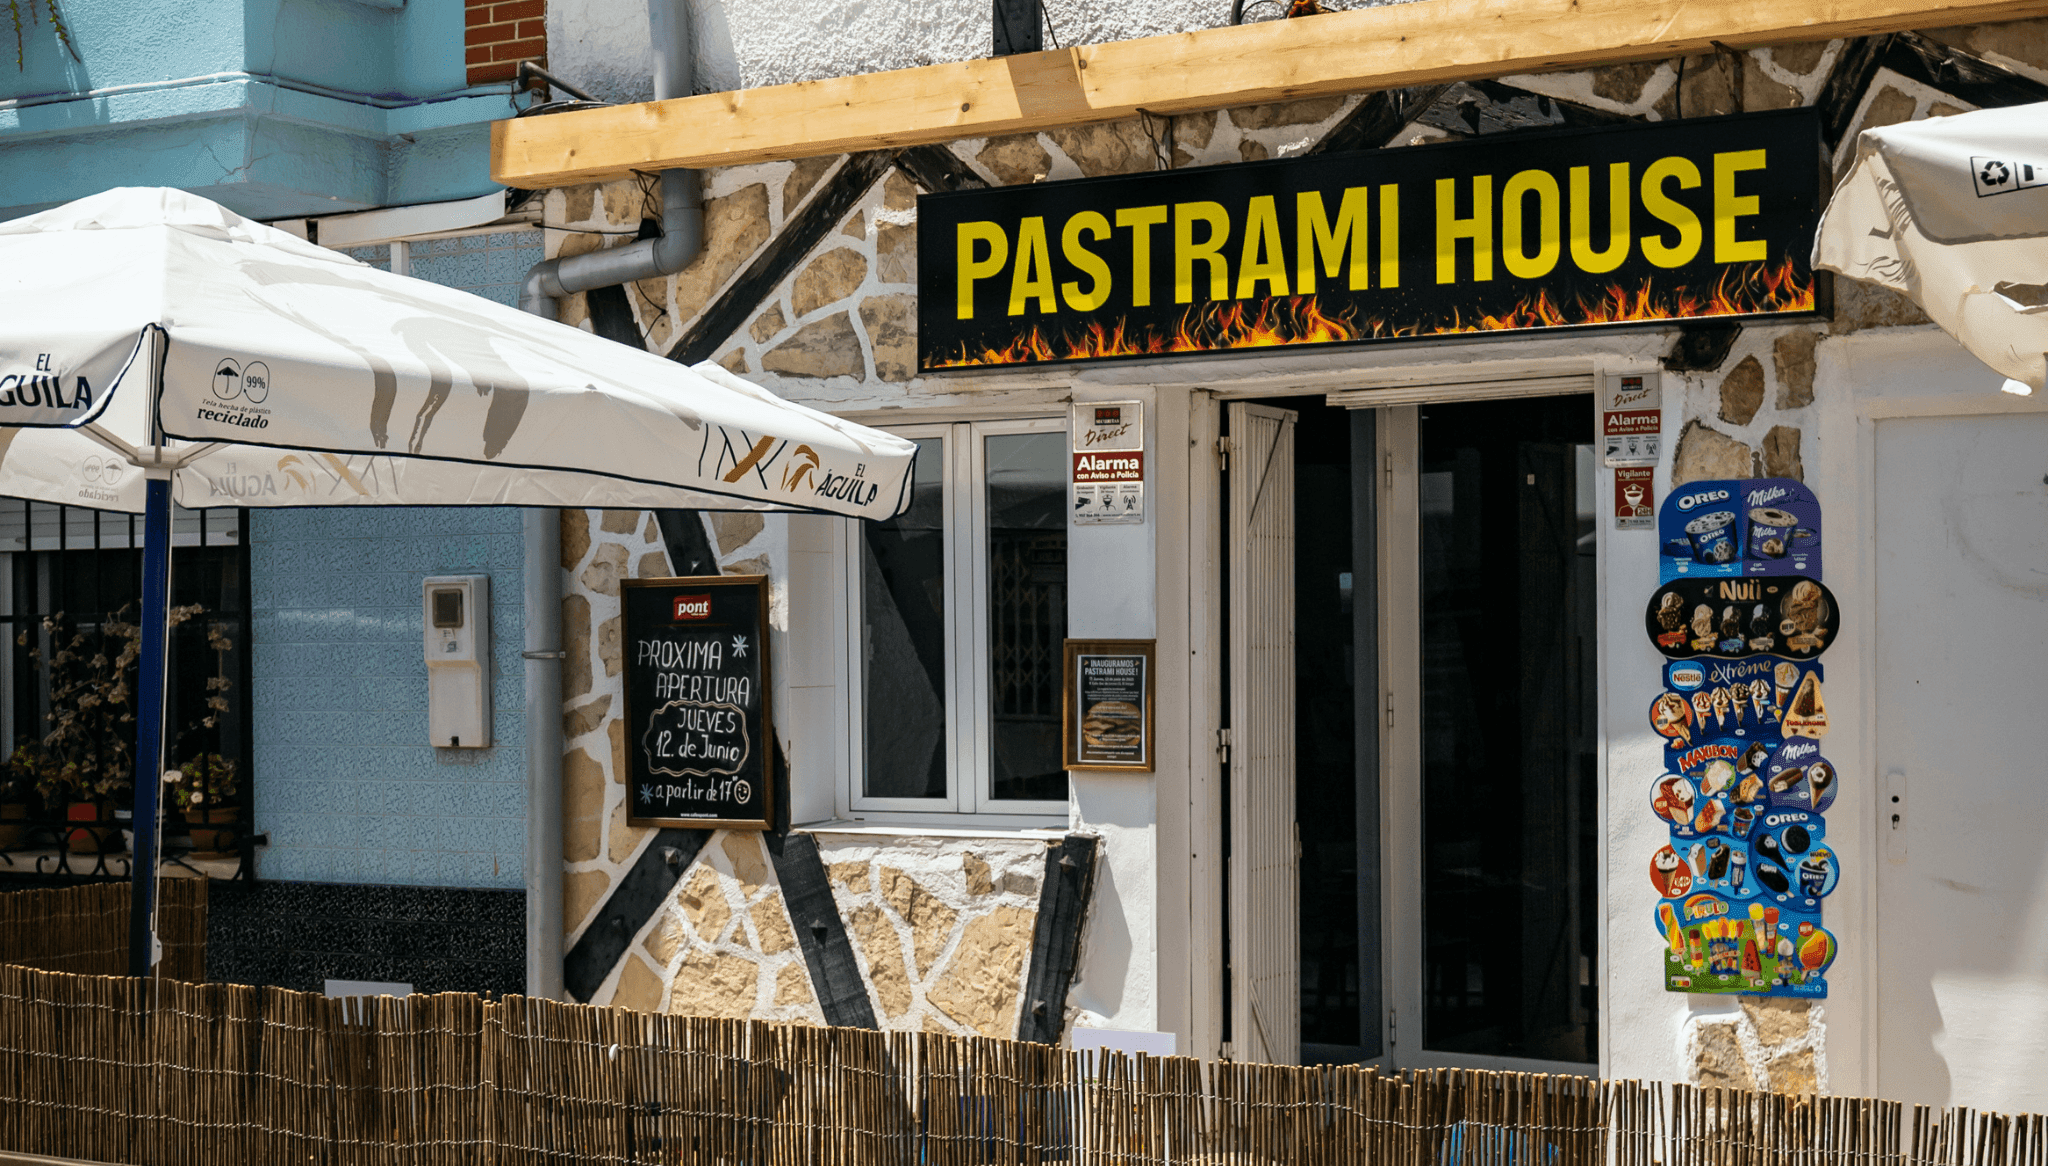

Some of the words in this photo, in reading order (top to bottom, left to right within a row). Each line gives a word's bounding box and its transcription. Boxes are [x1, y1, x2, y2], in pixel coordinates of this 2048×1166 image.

[956, 184, 1399, 321] PASTRAMI
[1436, 149, 1768, 285] HOUSE
[36, 353, 51, 372] EL
[245, 375, 266, 390] 99%
[202, 398, 217, 407] Tela
[218, 402, 239, 412] hecha
[1613, 388, 1653, 407] Direct
[197, 407, 269, 429] reciclado
[1608, 414, 1659, 426] Alarma
[1084, 423, 1133, 447] Direct
[855, 463, 866, 478] EL
[1076, 455, 1139, 471] Alarma
[1090, 471, 1109, 480] Aviso
[1617, 469, 1651, 479] Vigilante
[815, 469, 878, 506] ÁGUILA
[1747, 486, 1787, 507] Milka
[1678, 490, 1730, 510] OREO
[1752, 526, 1777, 539] Milka
[1720, 579, 1762, 600] Nuii
[678, 601, 709, 616] pont
[637, 640, 722, 671] PROXIMA
[1090, 659, 1134, 668] INAUGURAMOS
[1084, 667, 1115, 676] PASTRAMI
[1709, 660, 1772, 685] extrême
[656, 672, 750, 706] APERTURA
[677, 707, 736, 733] JUEVES
[1785, 719, 1827, 727] TOBLERONE
[678, 732, 697, 758] de
[698, 732, 739, 762] Junio
[1781, 742, 1818, 760] Milka
[1677, 744, 1738, 774] MAXIBON
[655, 785, 665, 799] a
[666, 778, 704, 807] partir
[706, 777, 718, 802] de
[1765, 812, 1809, 827] OREO
[1683, 901, 1729, 921] PIRULO
